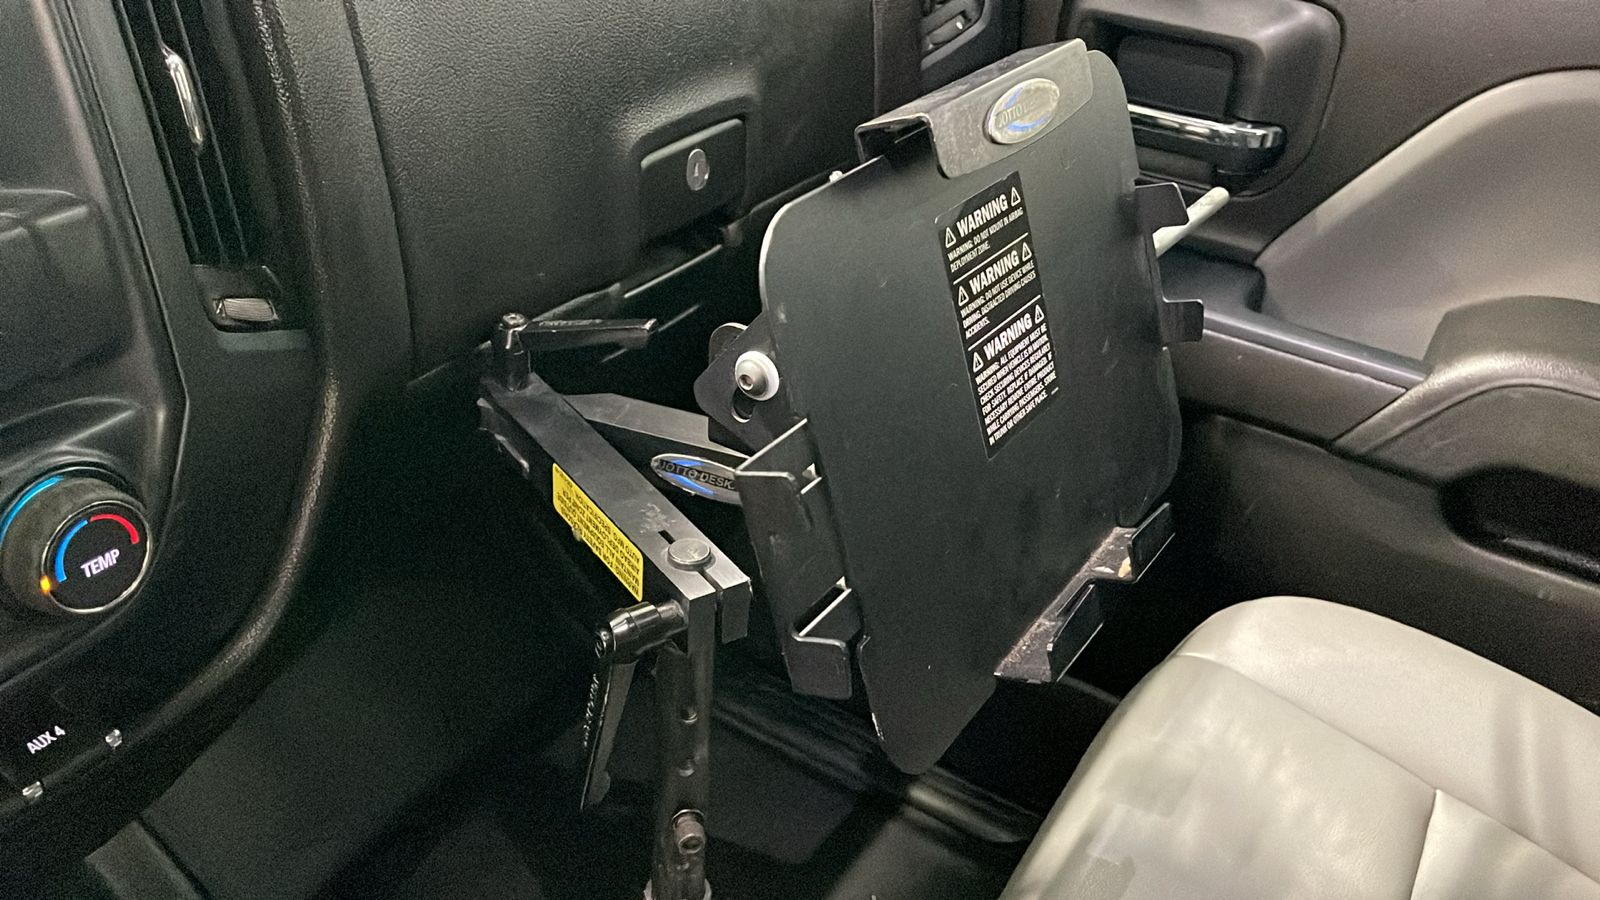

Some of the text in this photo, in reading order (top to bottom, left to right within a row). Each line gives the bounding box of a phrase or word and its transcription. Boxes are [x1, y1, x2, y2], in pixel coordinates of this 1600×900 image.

[948, 207, 1023, 261] WARNING: DO NOT MOUNT IN AIRBAG
[957, 195, 1008, 236] WARNING
[950, 248, 977, 272] DEPLOYMENT
[970, 251, 1019, 294] WARNING
[961, 260, 1034, 317] WARNING: DO NOT USE DEVICE WHILE
[981, 293, 1005, 315] DISTRACTED
[1005, 281, 1021, 298] DRIVING
[1021, 270, 1036, 286] CAUSES
[975, 323, 1047, 384] WARNING: ALL EQUIPMENT MUST BE
[984, 314, 1032, 359] WARNING
[978, 375, 997, 395] SECURED
[996, 366, 1009, 379] WHEN
[1008, 352, 1024, 370] VEHICLE
[1023, 349, 1029, 358] IS
[1028, 346, 1033, 354] IN
[980, 343, 1050, 405] CHECK SECURING DEVICES REGULARLY
[982, 403, 991, 415] FOR
[1007, 375, 1024, 394] REPLACE
[1024, 371, 1028, 380] IF
[1047, 351, 1052, 360] IF
[985, 401, 1007, 425] NECESSARY
[1007, 387, 1024, 405] REMOVE
[1024, 376, 1037, 392] ENTIRE
[1037, 361, 1054, 380] PRODUCT
[987, 419, 1000, 435] WHILE
[1000, 403, 1019, 424] CARRYING
[1044, 370, 1056, 386] STORE
[989, 436, 995, 445] IN
[994, 424, 1008, 440] TRUNK
[1007, 419, 1014, 429] OR
[1013, 408, 1026, 424] OTHER
[1025, 400, 1036, 413] SAFE
[562, 489, 571, 503] PER
[80, 548, 120, 578] TEMP
[603, 552, 613, 568] FOR
[605, 544, 615, 559] ALL
[625, 545, 639, 564] AUTO
[26, 725, 66, 754] AUX 4
